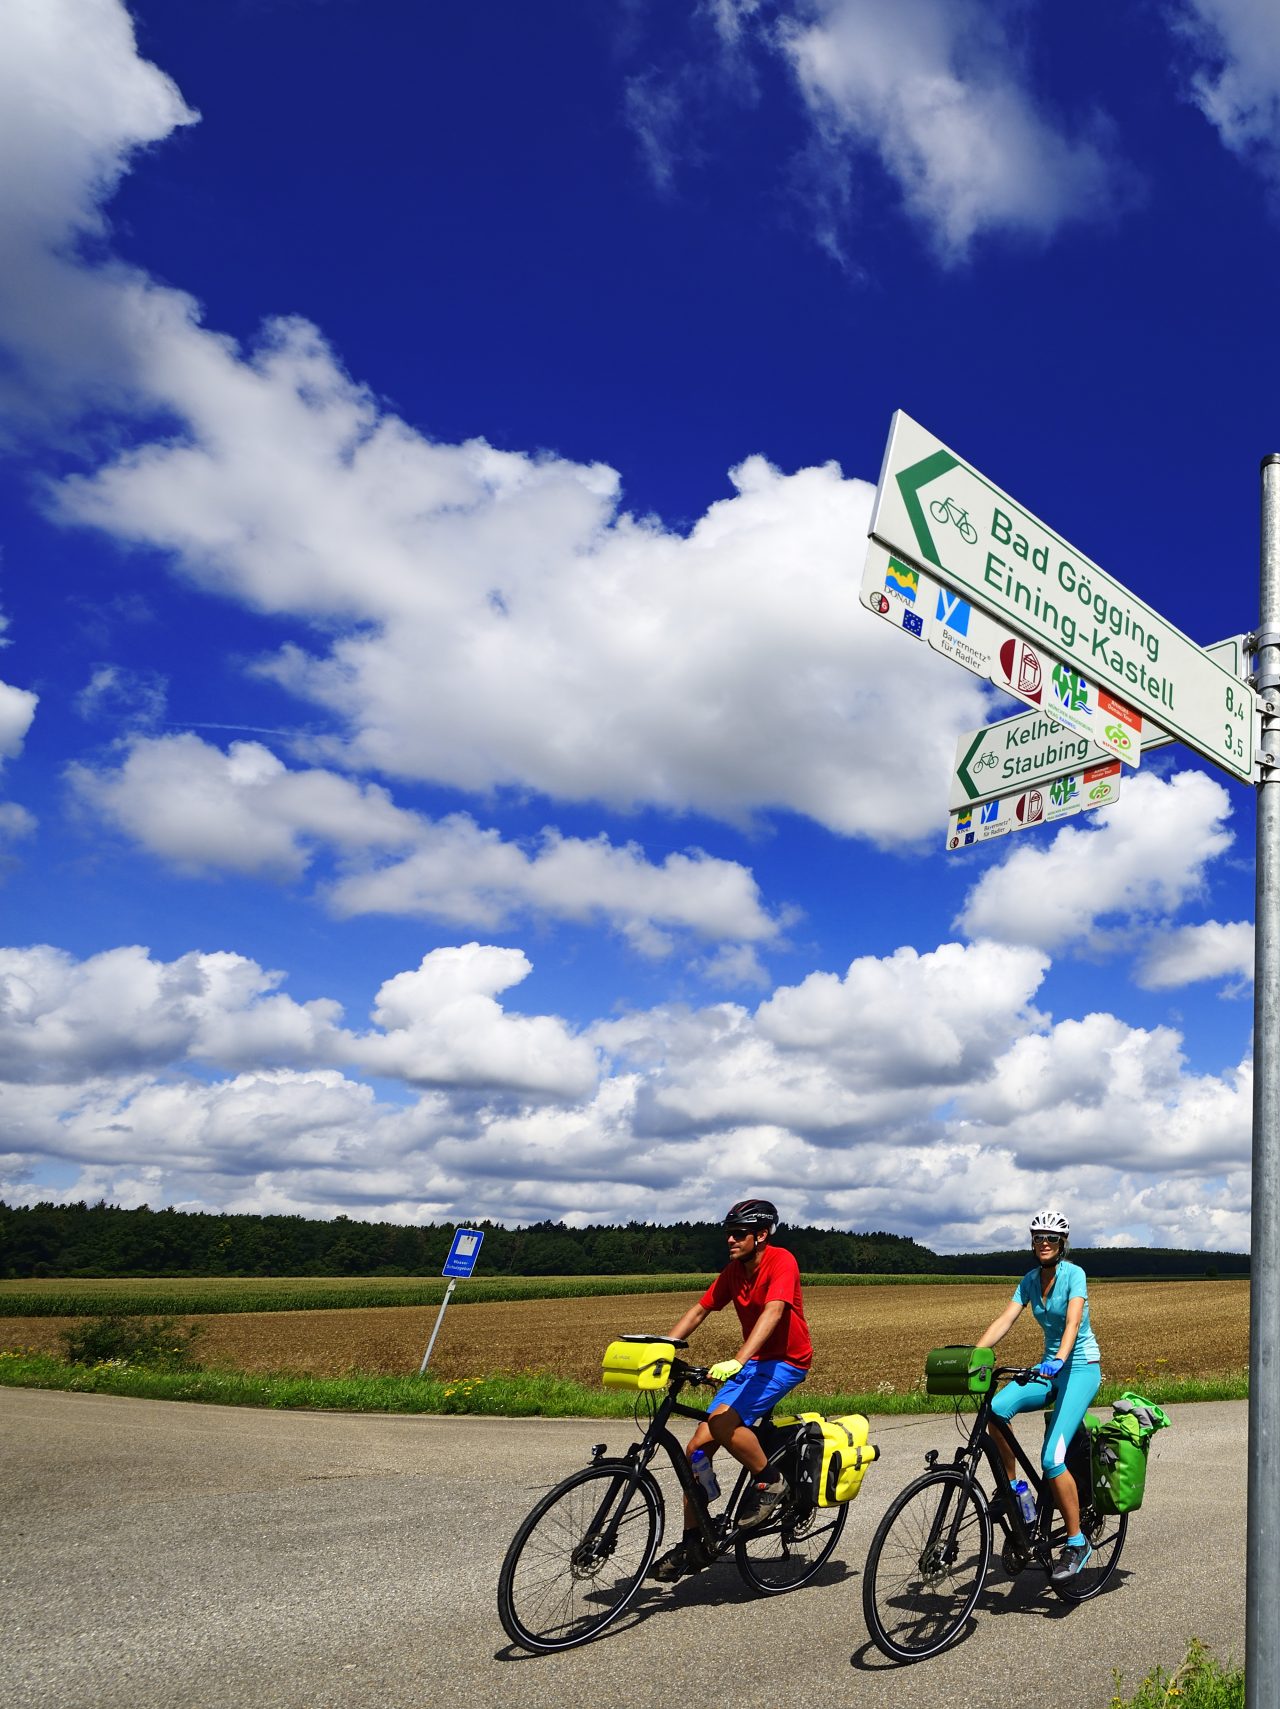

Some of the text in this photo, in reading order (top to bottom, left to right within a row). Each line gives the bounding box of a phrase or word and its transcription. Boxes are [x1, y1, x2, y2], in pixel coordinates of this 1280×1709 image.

[990, 507, 1160, 663] Bad Gögging
[910, 619, 916, 627] 6
[983, 551, 1175, 711] Eining-Kastell
[955, 646, 981, 670] Radler
[1225, 686, 1244, 721] 8,4
[1005, 719, 1065, 750] Kelhe
[1224, 723, 1244, 758] 3,5
[1001, 738, 1089, 779] Staubing
